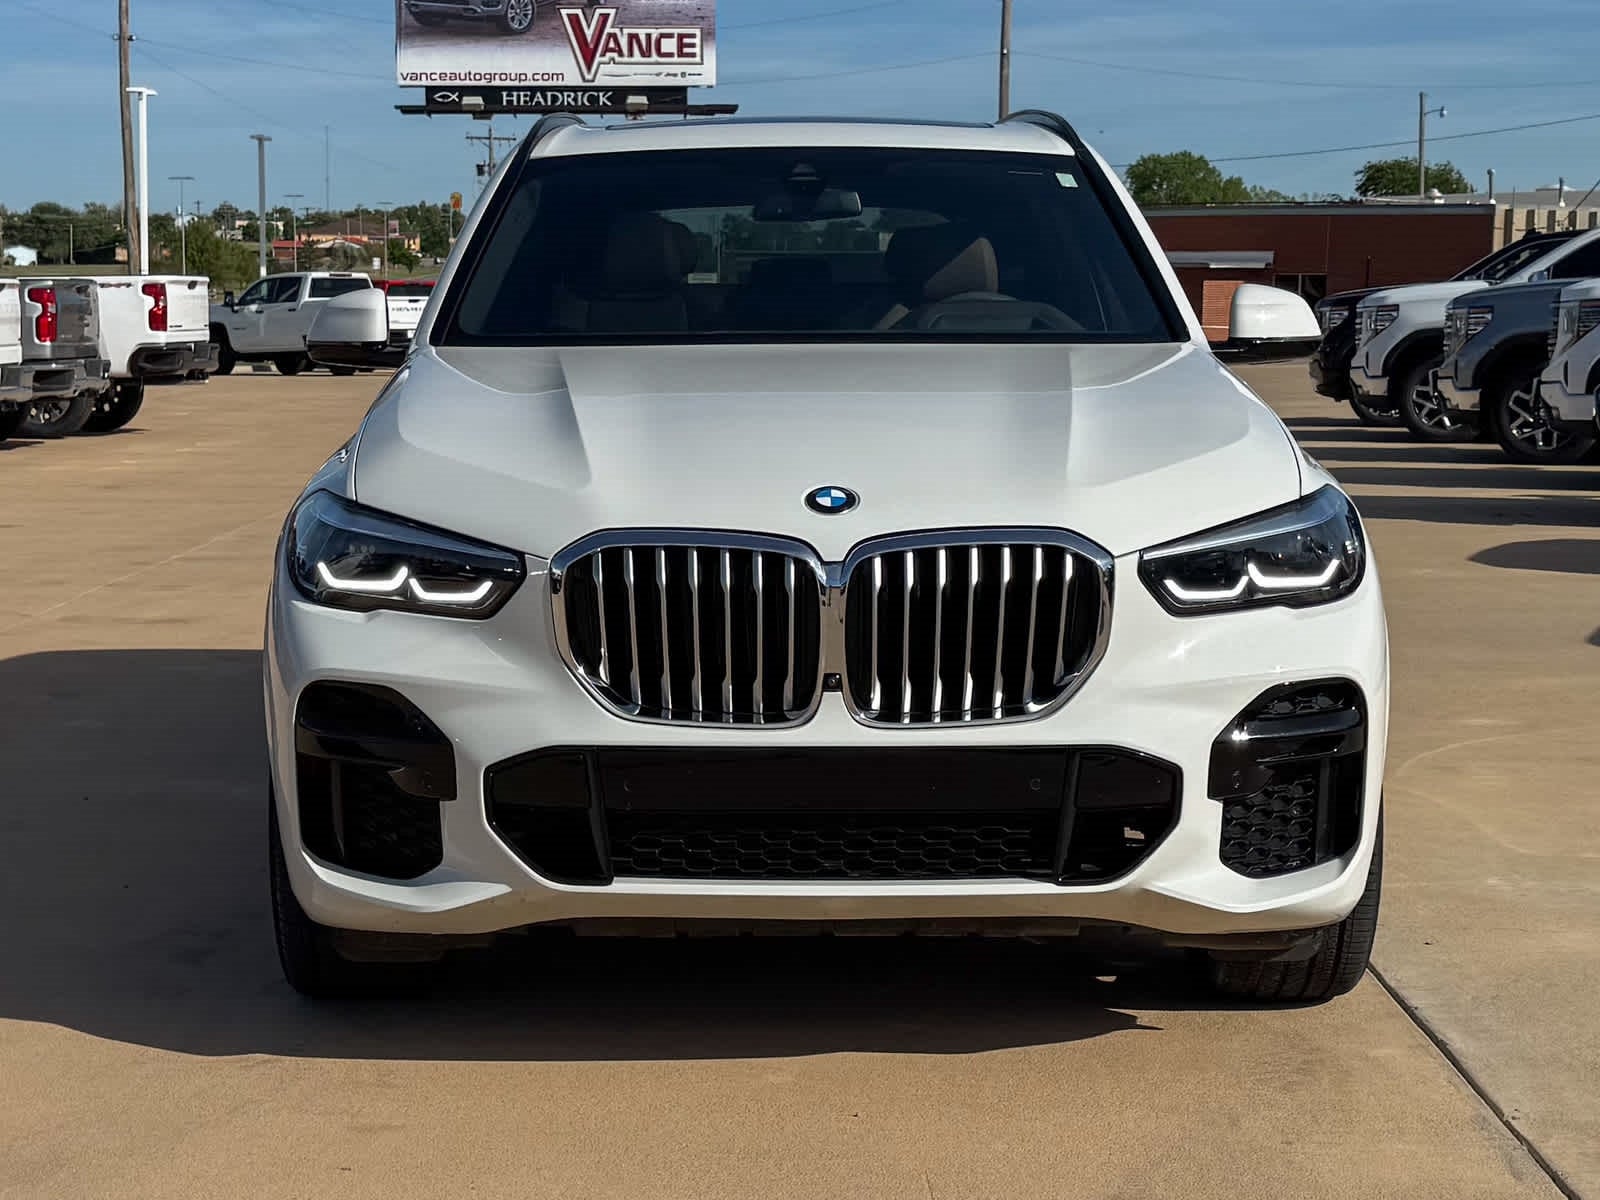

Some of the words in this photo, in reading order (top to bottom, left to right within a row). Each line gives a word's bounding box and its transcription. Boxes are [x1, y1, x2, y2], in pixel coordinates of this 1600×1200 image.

[561, 9, 702, 80] VANCE
[400, 70, 565, 83] vanceautogroup.com
[501, 91, 613, 106] HEADRICK
